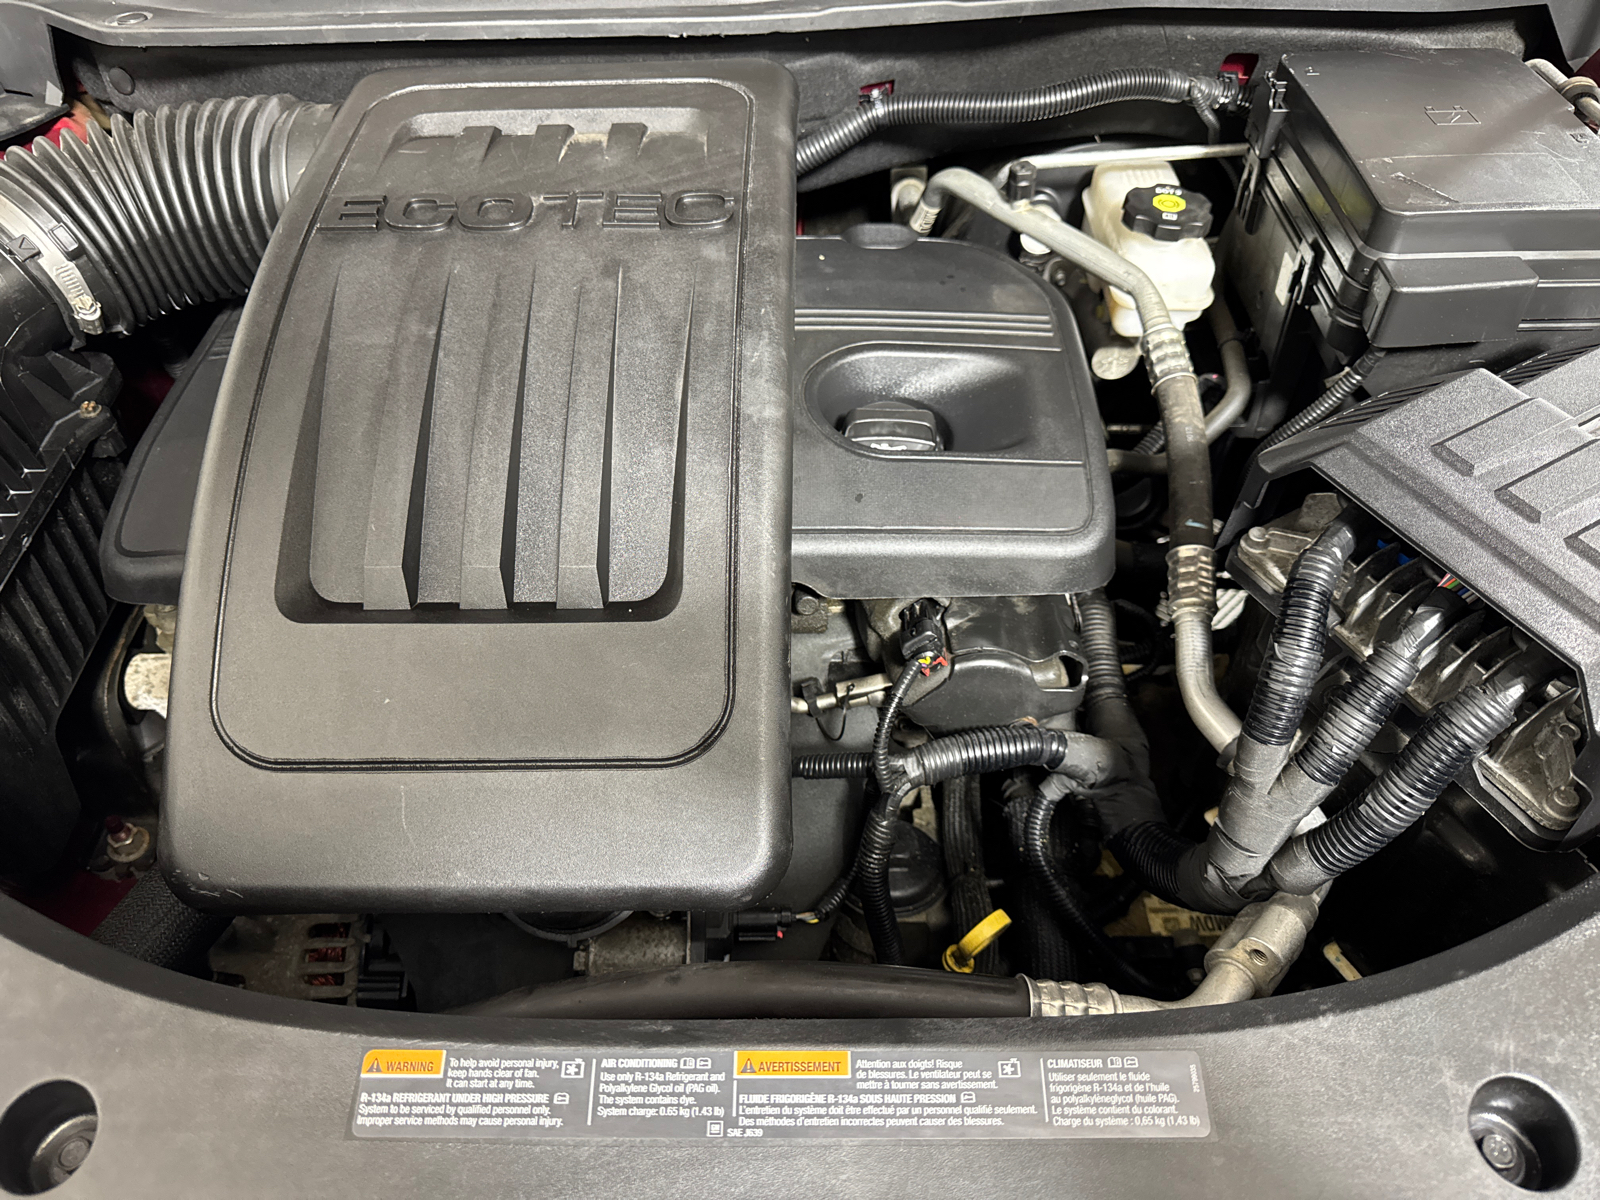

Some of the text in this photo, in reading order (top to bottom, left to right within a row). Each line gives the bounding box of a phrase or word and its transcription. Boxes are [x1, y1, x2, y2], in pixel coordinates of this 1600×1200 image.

[316, 190, 735, 233] ECOTEC
[386, 1061, 434, 1072] WARNING
[449, 1058, 559, 1070] To help avoid personal injury,
[601, 1058, 678, 1068] AIR CONDITIONING
[758, 1061, 841, 1072] AVERTISSEMENT
[855, 1059, 963, 1070] Attention aux doigts! Risque
[1047, 1059, 1103, 1068] CLIMATISEUR
[447, 1068, 540, 1079] keep hands clear of fan.
[600, 1072, 726, 1083] Use only R-134a Refrigerant and
[856, 1070, 993, 1080] de blessures. Le ventilateur peut se
[1048, 1072, 1151, 1081] Utiliser seulement le fluide
[446, 1079, 535, 1090] It can start at any time.
[599, 1083, 721, 1095] Polyalkylene Glycol oil (PAG oil).
[856, 1080, 999, 1089] mettre à tourner sans avertissement.
[1049, 1083, 1092, 1094] frigorigène
[1093, 1083, 1123, 1092] R-134a
[1124, 1083, 1132, 1092] et
[1133, 1083, 1144, 1092] de
[360, 1092, 550, 1103] R-134a REFRIGERANT UNDER HIGH PRESSURE
[598, 1095, 697, 1106] The system contains dye.
[739, 1094, 770, 1103] FLUIDE
[827, 1094, 858, 1103] R-134a
[859, 1094, 883, 1103] SOUS
[884, 1094, 913, 1103] HAUTE
[913, 1094, 956, 1103] PRESSION
[1050, 1094, 1061, 1104] au
[1135, 1094, 1157, 1104] (huile
[1158, 1094, 1180, 1104] PAG).
[358, 1104, 551, 1115] System to be serviced by qualified personnel only.
[597, 1106, 725, 1117] System charge: 0.65 kg (1.43 lb)
[782, 1105, 793, 1115] du
[794, 1105, 828, 1116] système
[828, 1105, 844, 1115] doit
[845, 1105, 861, 1115] être
[862, 1105, 895, 1115] effectué
[896, 1106, 910, 1116] par
[911, 1105, 922, 1115] un
[923, 1105, 962, 1116] personnel
[963, 1105, 993, 1115] qualifié
[994, 1105, 1038, 1115] seulement.
[1051, 1105, 1179, 1116] Le système contient du colorant.
[356, 1115, 563, 1127] Improper service methods may cause personal injury.
[738, 1117, 755, 1126] Des
[756, 1117, 795, 1126] méthodes
[840, 1117, 884, 1126] incorrectes
[885, 1117, 918, 1128] peuvent
[919, 1117, 946, 1126] causer
[947, 1117, 963, 1126] des
[963, 1117, 1005, 1126] blessures.
[1052, 1116, 1082, 1127] Charge
[1083, 1116, 1094, 1126] du
[1095, 1116, 1129, 1127] système
[1135, 1116, 1152, 1126] 0,65
[1155, 1116, 1166, 1127] kg
[1166, 1116, 1188, 1127] (1,43
[1189, 1116, 1201, 1127] lb)
[727, 1128, 763, 1137] SAE J639
